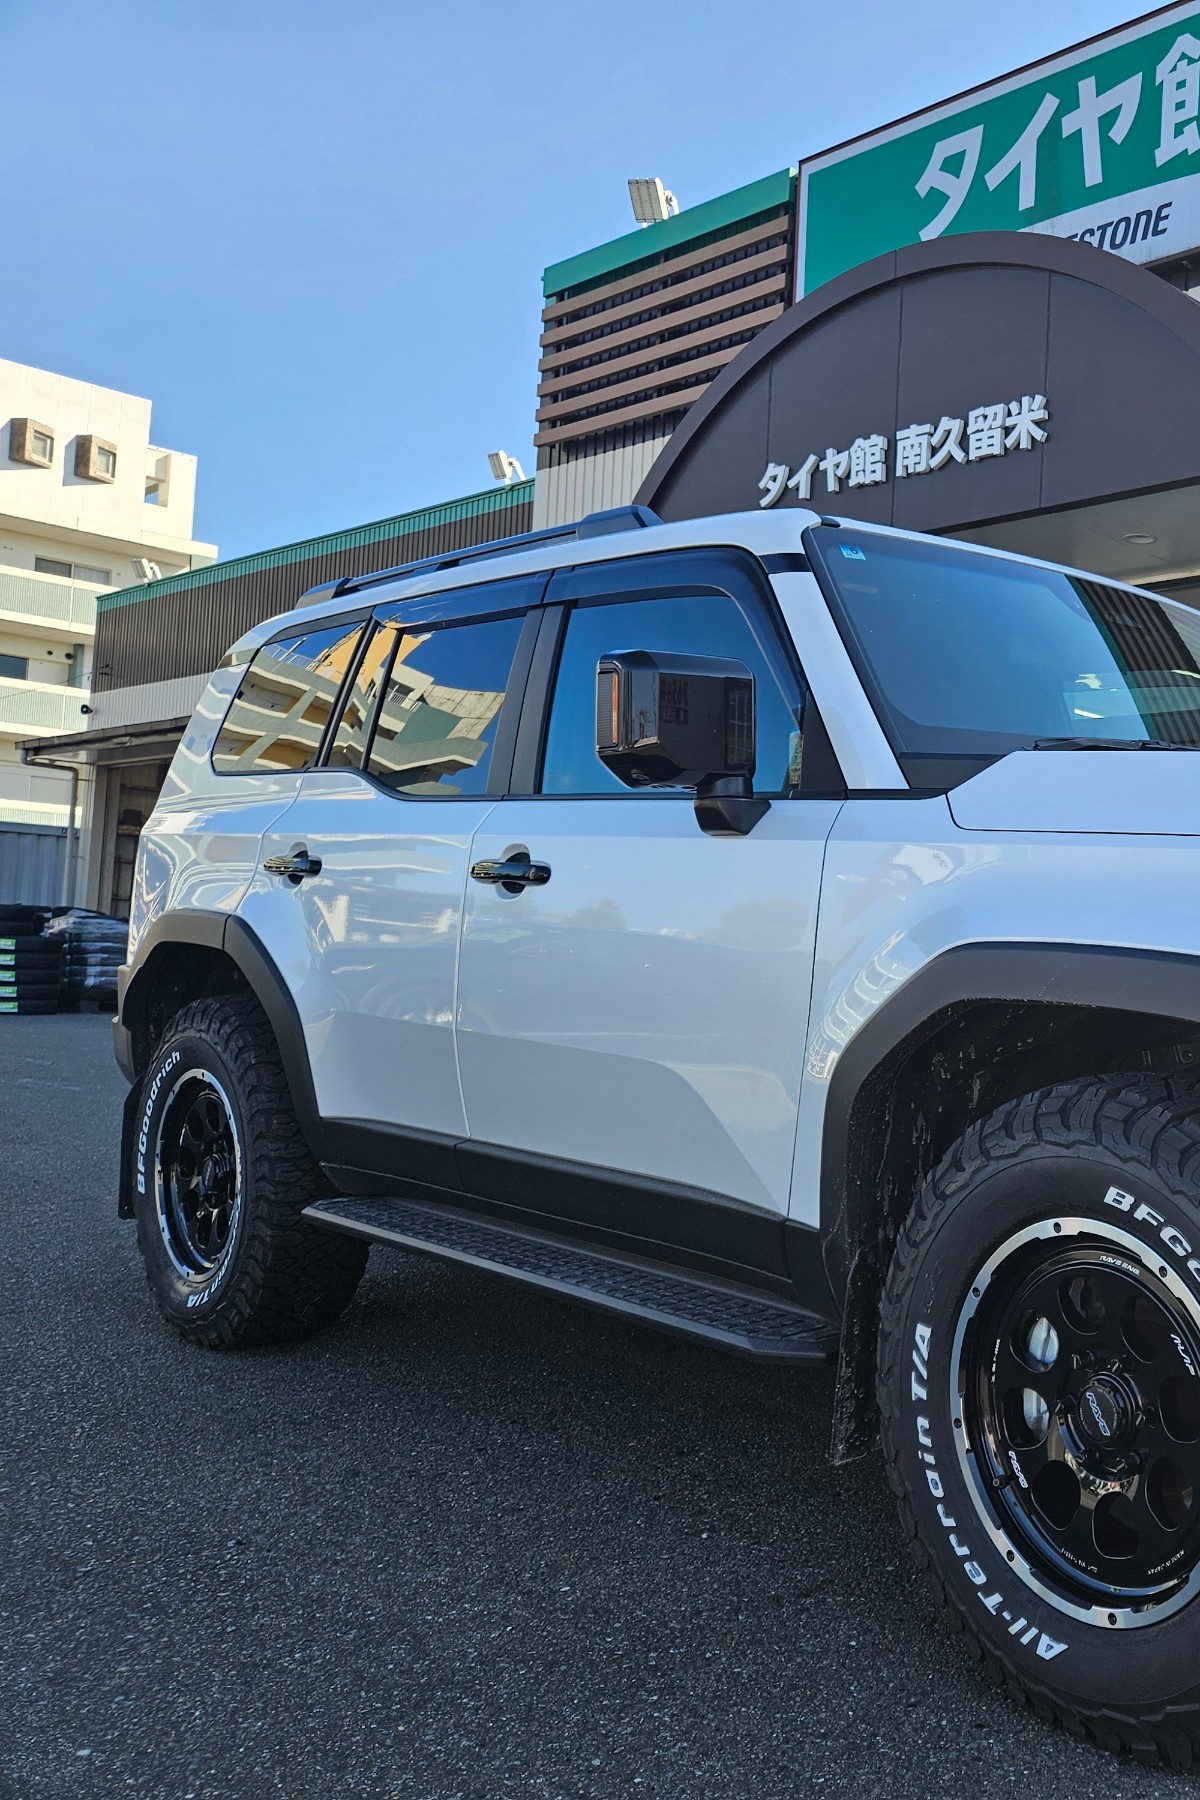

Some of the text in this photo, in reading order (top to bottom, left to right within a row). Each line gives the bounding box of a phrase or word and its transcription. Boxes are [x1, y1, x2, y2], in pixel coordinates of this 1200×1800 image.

[757, 394, 1049, 509] タイヤ館 南久留米
[137, 1050, 181, 1194] BFGoodrich
[1099, 1255, 1122, 1266] RAYS
[1086, 1391, 1111, 1437] RAYS
[911, 1324, 1070, 1661] All-Terrain T/A
[1008, 1450, 1029, 1489] RAYS
